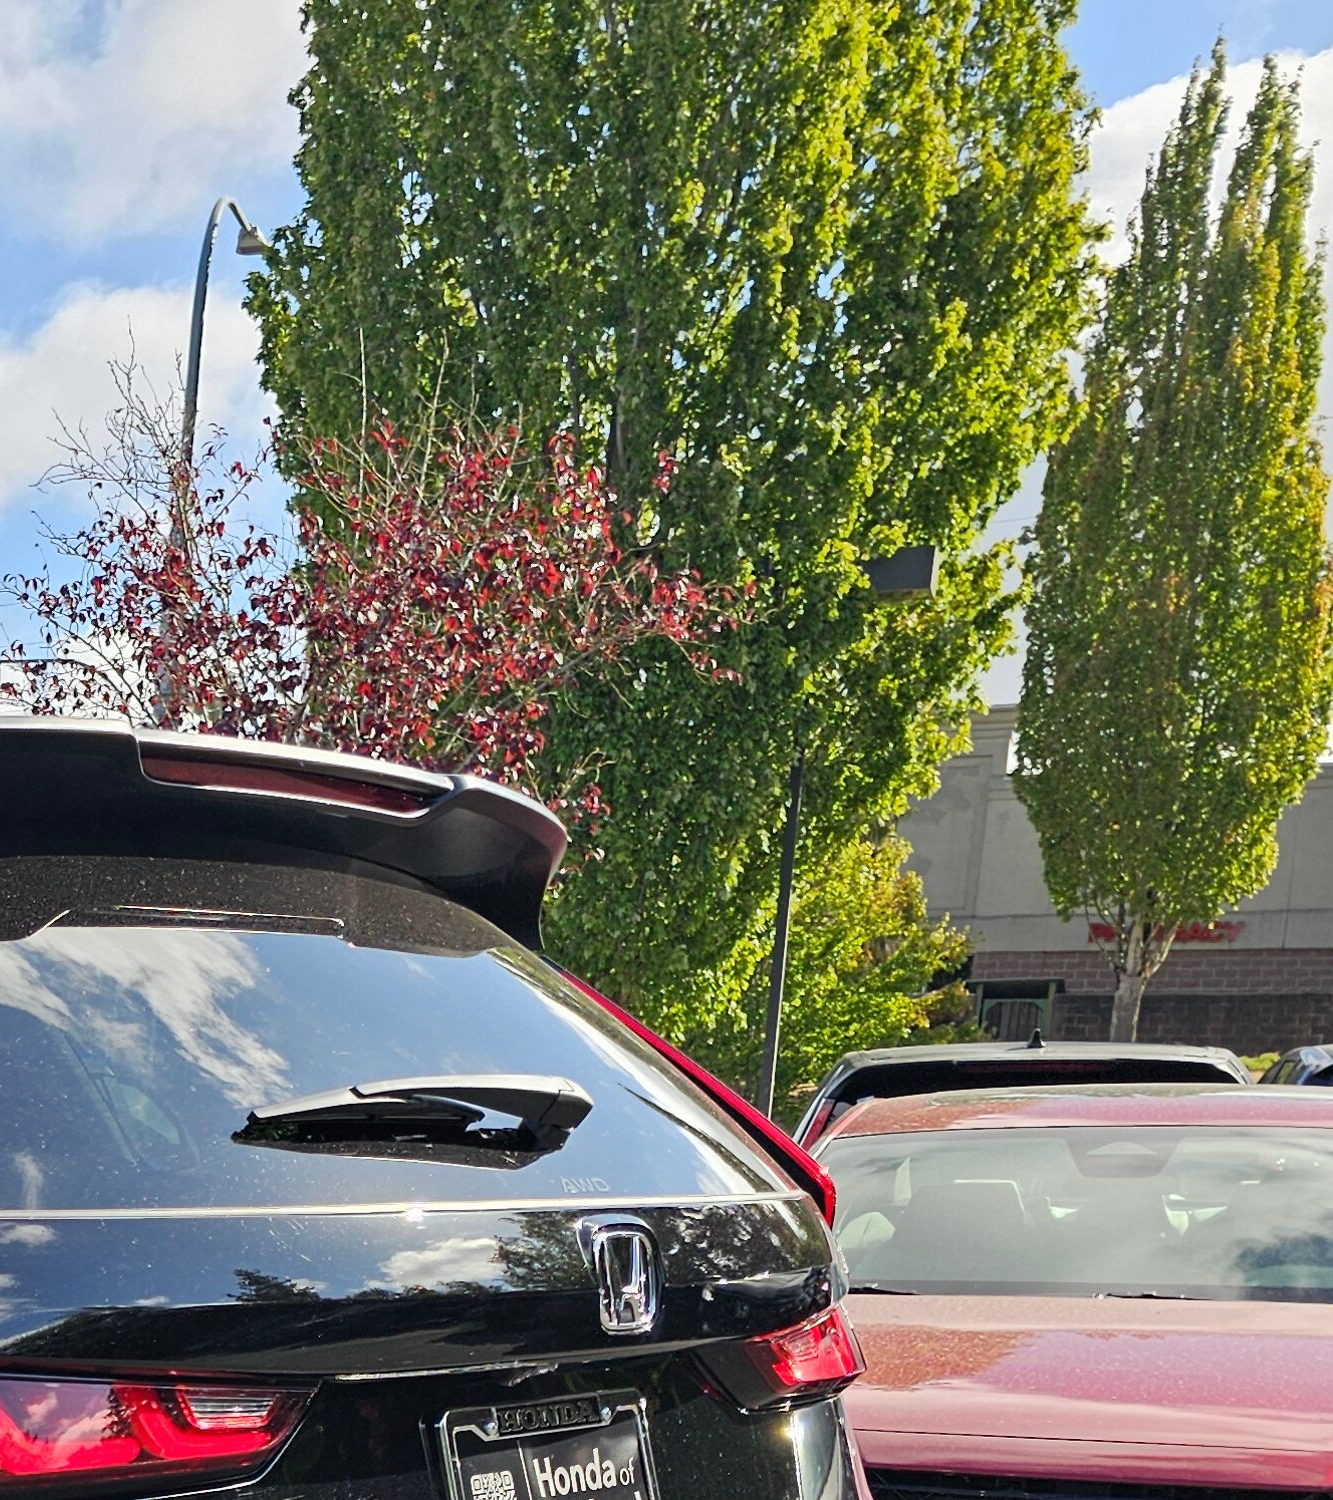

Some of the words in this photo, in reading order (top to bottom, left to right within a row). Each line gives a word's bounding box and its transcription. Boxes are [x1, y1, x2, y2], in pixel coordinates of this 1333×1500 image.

[560, 1176, 610, 1194] AWD
[498, 1402, 601, 1432] HONDA
[533, 1448, 616, 1498] Honda
[619, 1456, 635, 1486] of
